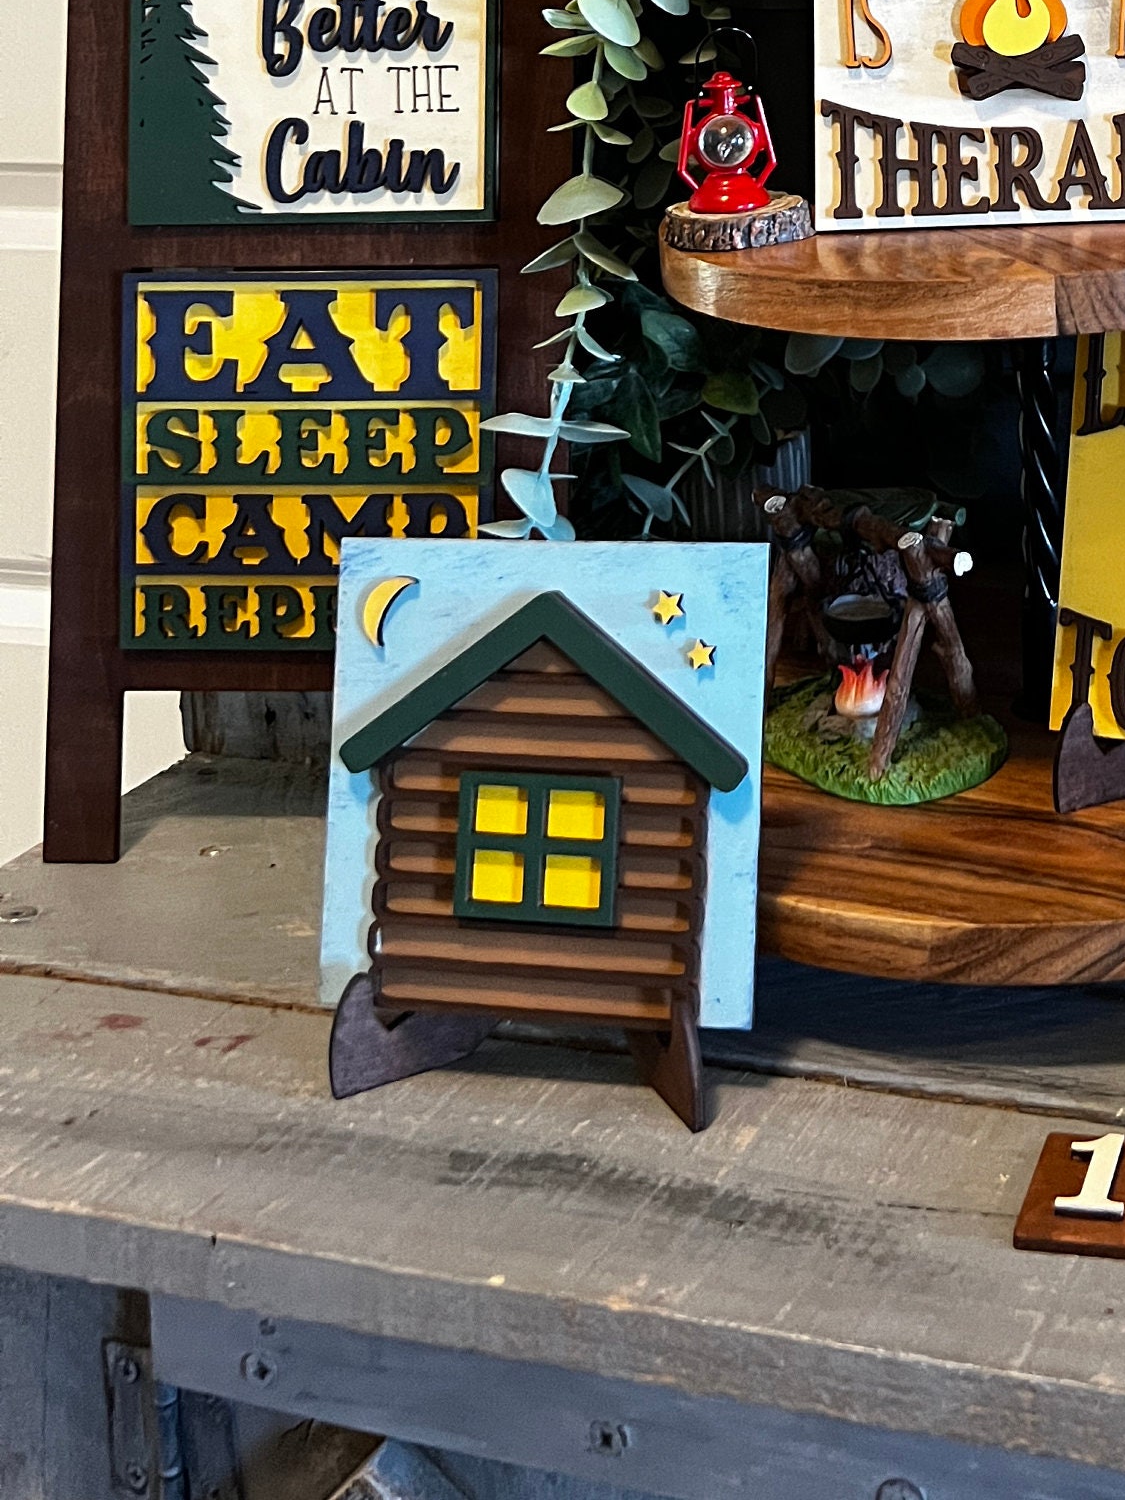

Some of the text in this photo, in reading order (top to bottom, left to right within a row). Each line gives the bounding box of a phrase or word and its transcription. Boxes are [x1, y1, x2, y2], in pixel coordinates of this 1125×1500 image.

[313, 65, 460, 115] AT THE
[266, 117, 460, 204] Cabin
[144, 288, 474, 395] EAT
[146, 408, 472, 478] SLEEP
[1054, 1133, 1125, 1219] 1
